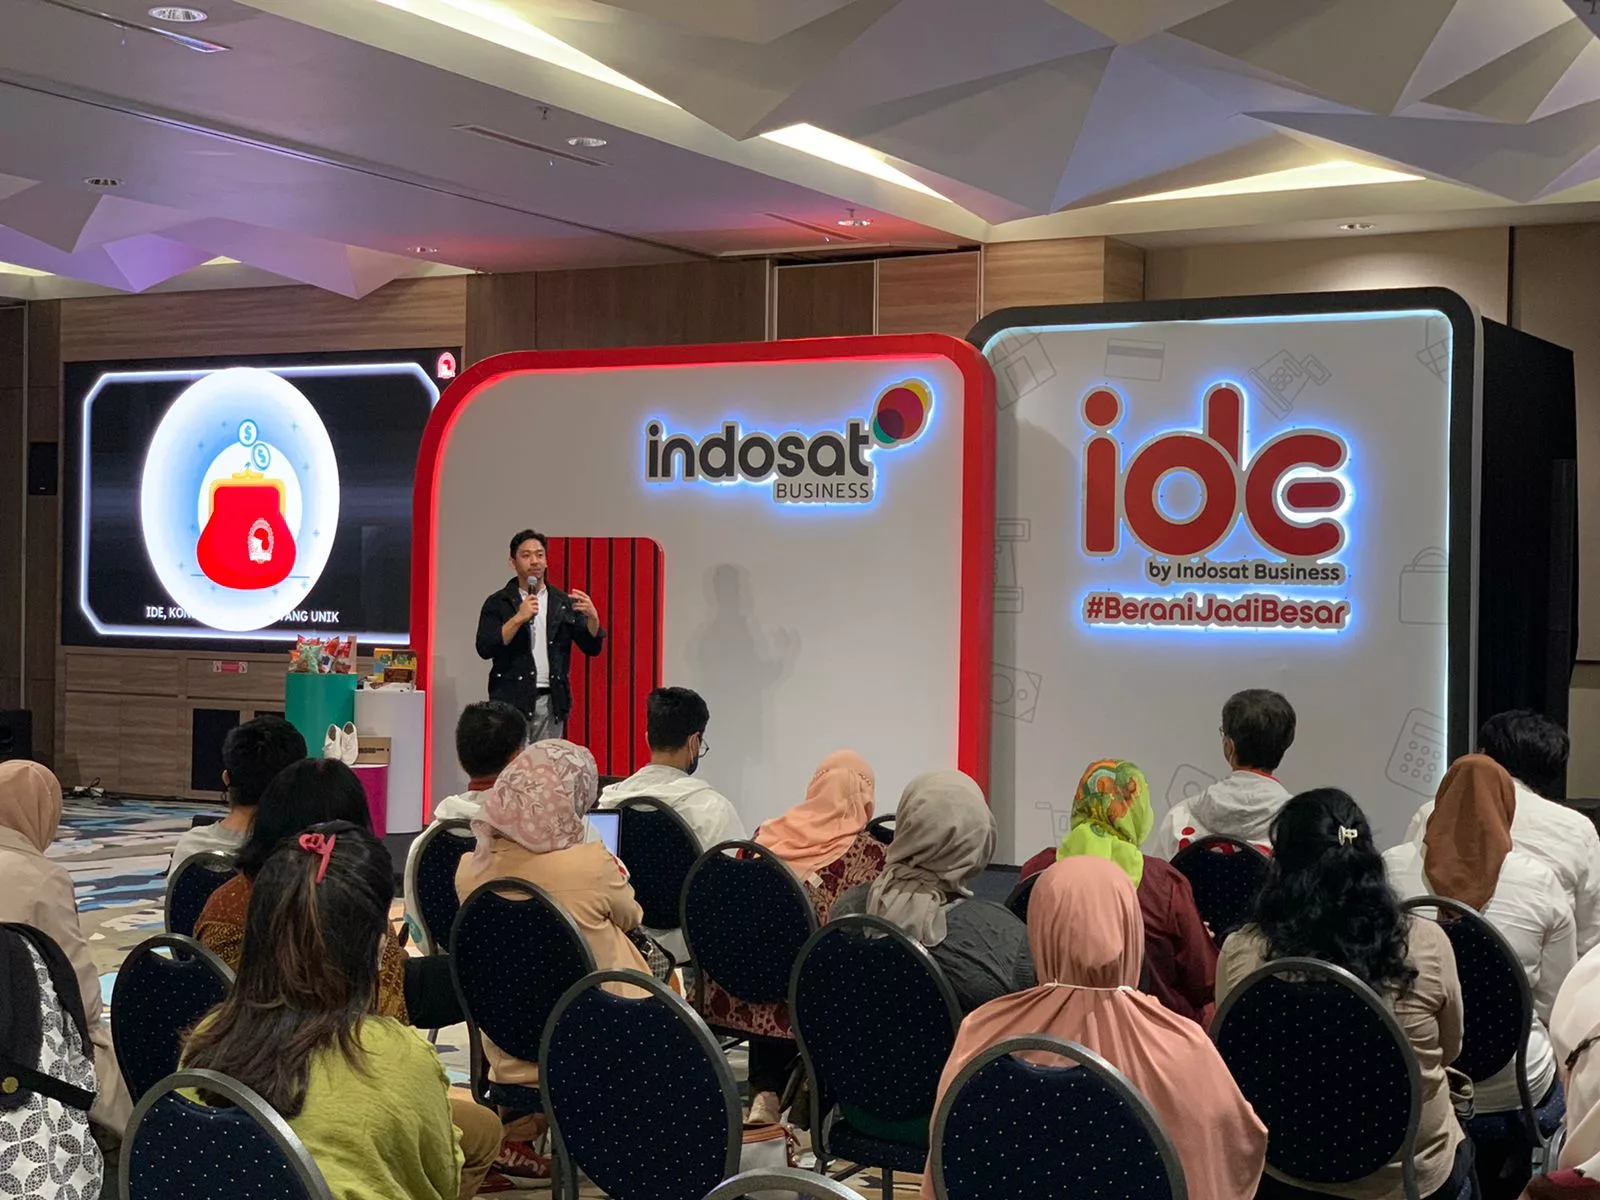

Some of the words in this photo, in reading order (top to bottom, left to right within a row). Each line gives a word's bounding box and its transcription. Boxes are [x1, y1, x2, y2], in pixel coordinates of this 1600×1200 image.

[648, 422, 870, 478] indosat
[1085, 387, 1343, 556] ide
[775, 482, 870, 499] BUSINESS
[1149, 562, 1171, 581] by
[1177, 562, 1249, 579] Indosat
[1254, 563, 1340, 581] Business
[146, 606, 167, 620] IDE,
[311, 611, 340, 623] UNIK
[1086, 595, 1346, 624] #BeraniJadiBesar
